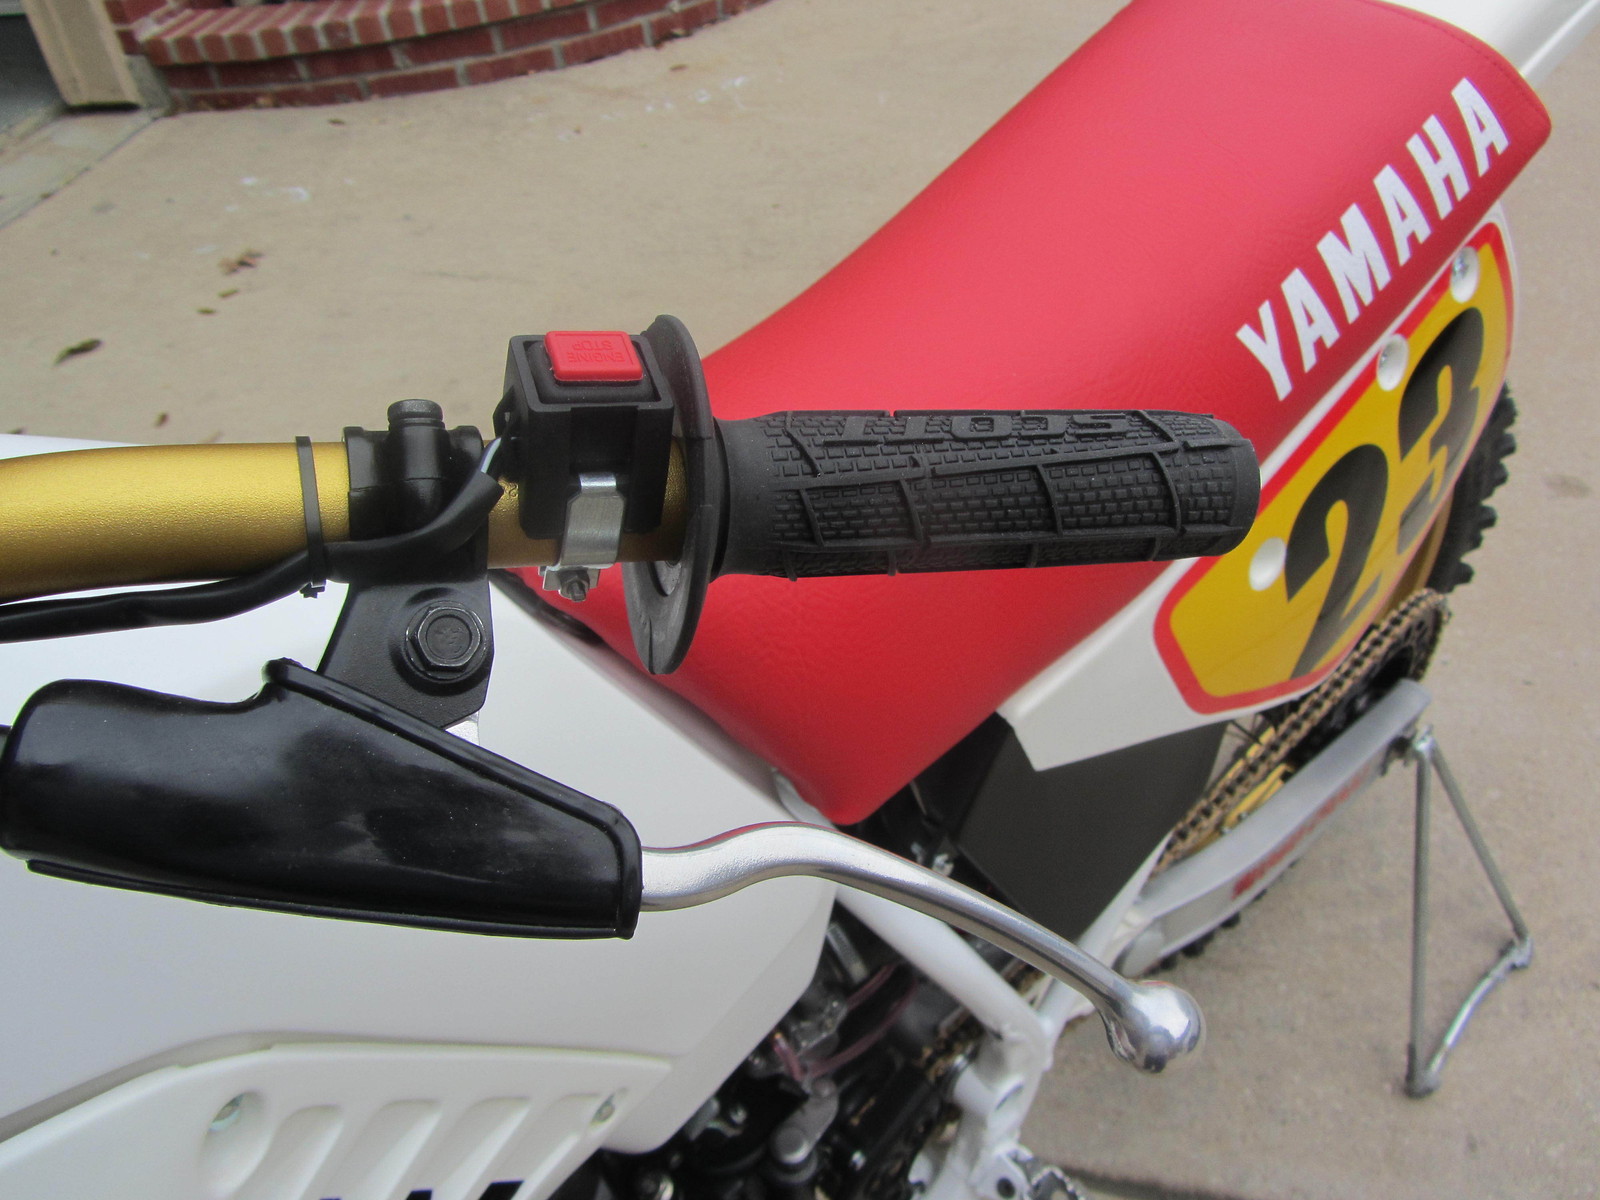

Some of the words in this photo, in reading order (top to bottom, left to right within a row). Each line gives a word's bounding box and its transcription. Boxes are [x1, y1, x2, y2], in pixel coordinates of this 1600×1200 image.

[1235, 77, 1509, 401] YAMAHA
[566, 351, 626, 362] ENGINE
[572, 340, 613, 351] STOP
[1284, 306, 1485, 680] 23
